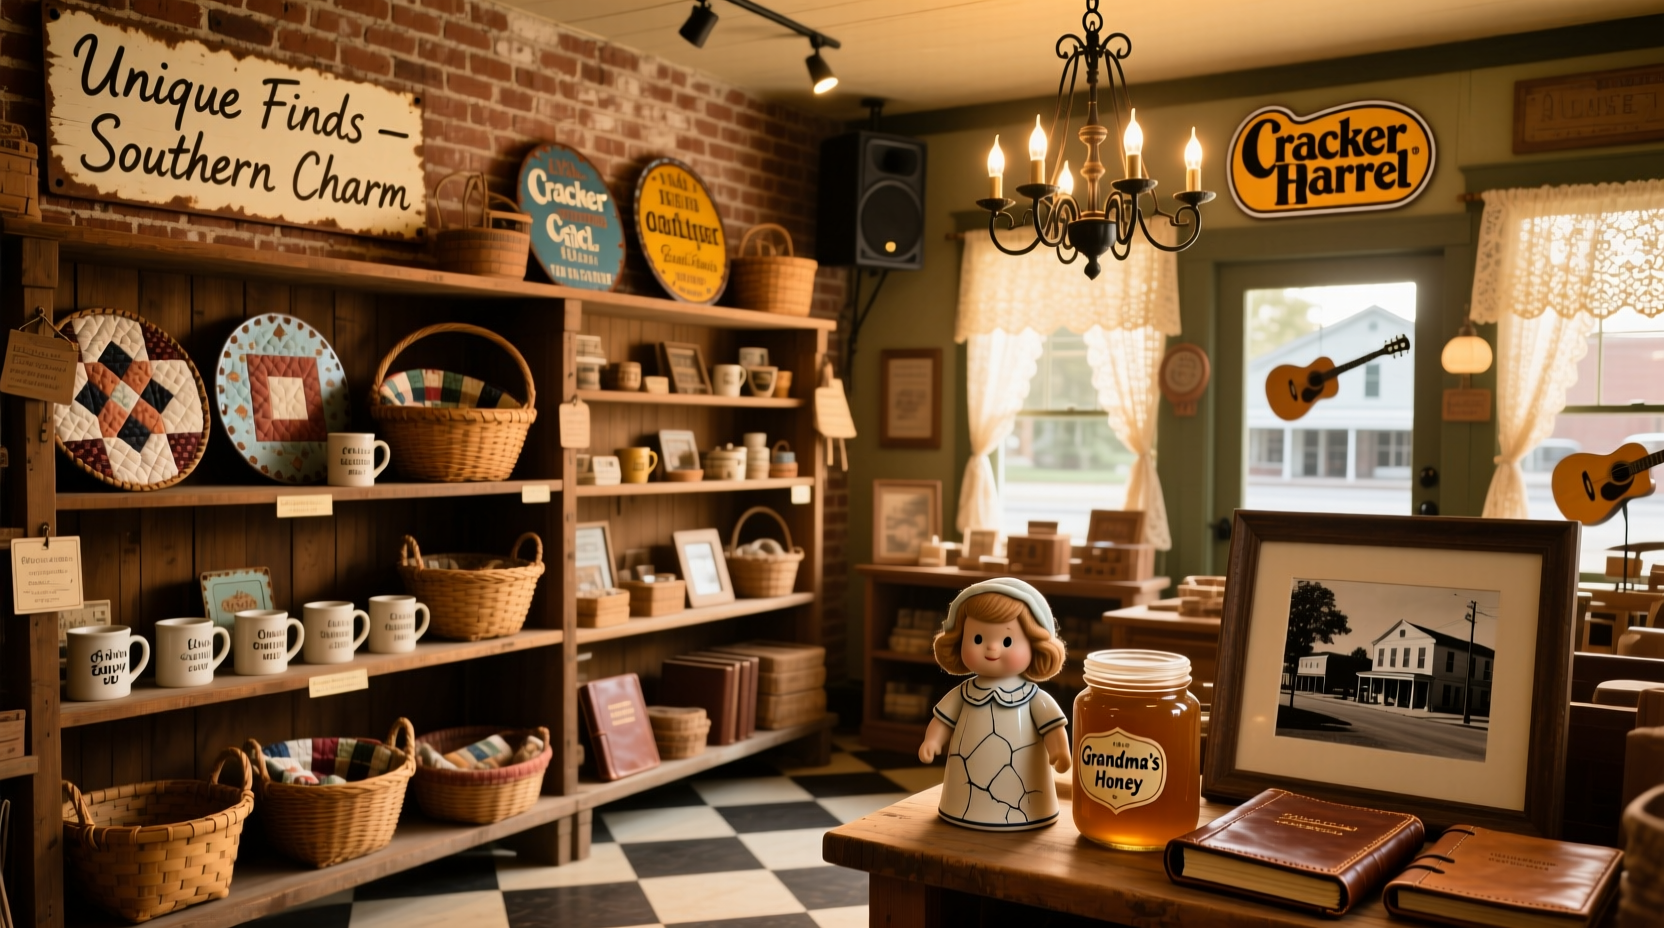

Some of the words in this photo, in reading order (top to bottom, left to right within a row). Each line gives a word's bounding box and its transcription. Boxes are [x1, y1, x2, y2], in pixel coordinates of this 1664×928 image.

[73, 33, 242, 131] Unique
[261, 78, 364, 144] Finds
[80, 112, 276, 192] Southern
[292, 150, 411, 211] Charm
[1241, 117, 1408, 179] Cracker
[1275, 148, 1412, 206] Harrel
[527, 167, 608, 212] Cracker
[1081, 745, 1160, 771] Grandma's
[1095, 770, 1143, 797] Honey
